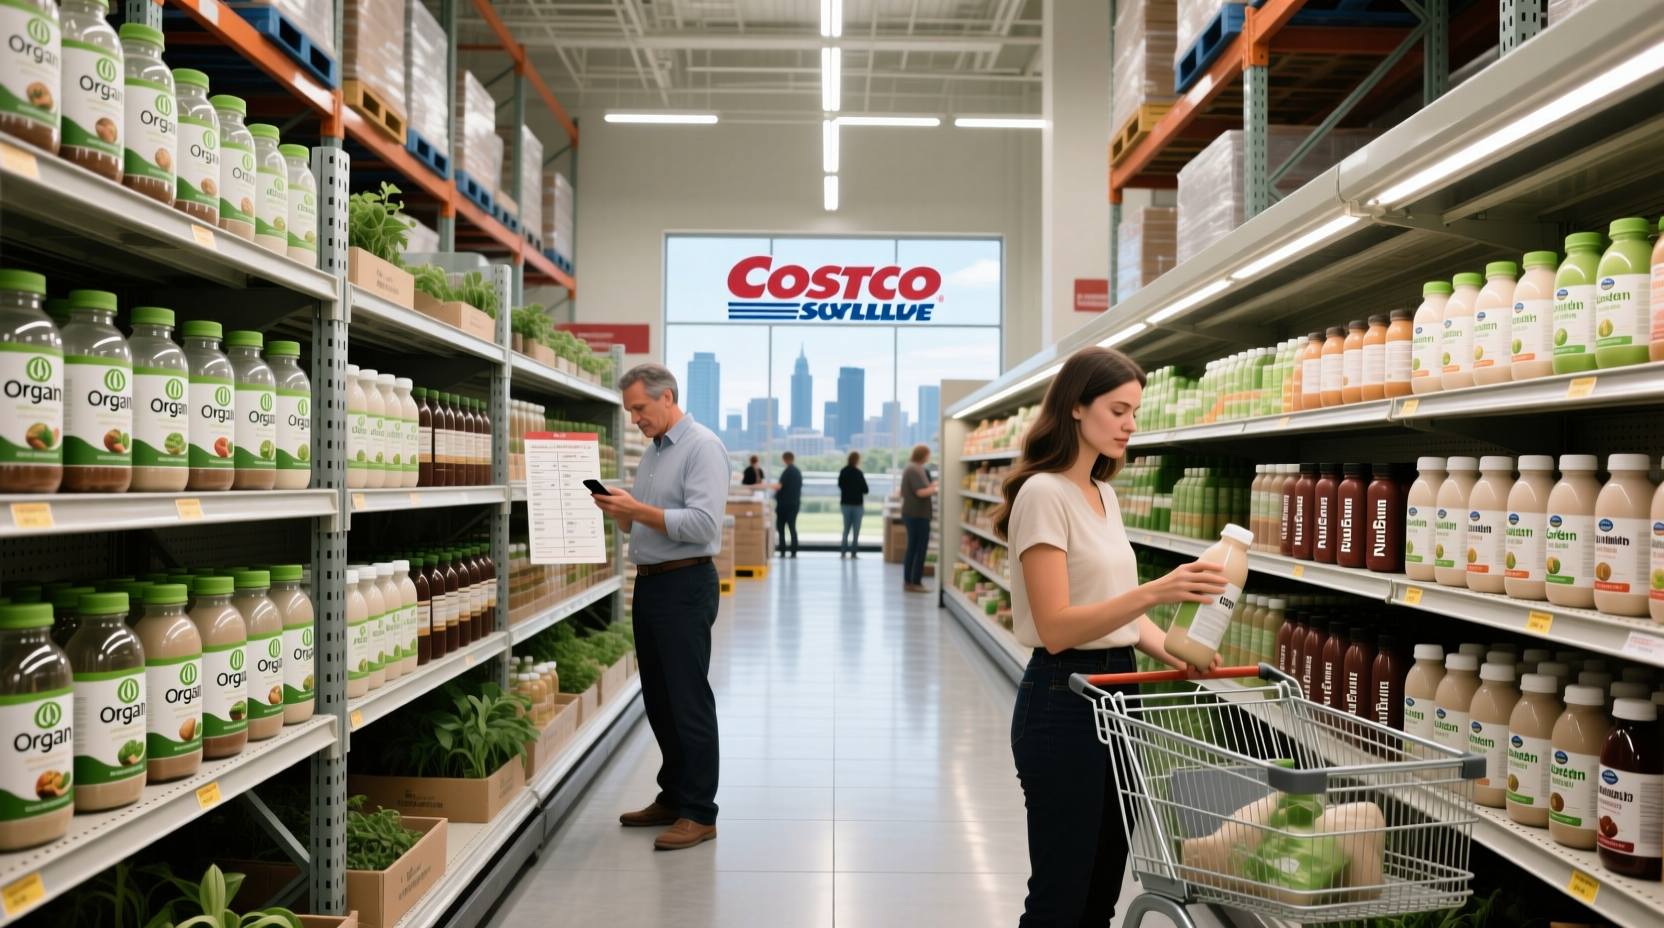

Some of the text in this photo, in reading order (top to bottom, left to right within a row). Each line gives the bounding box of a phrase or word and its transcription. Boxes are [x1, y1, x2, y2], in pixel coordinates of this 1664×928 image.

[727, 255, 942, 300] COSTCO
[4, 380, 62, 404] Organ
[87, 390, 132, 412] Organ
[100, 702, 146, 725] Organ
[14, 726, 72, 753] Organ
